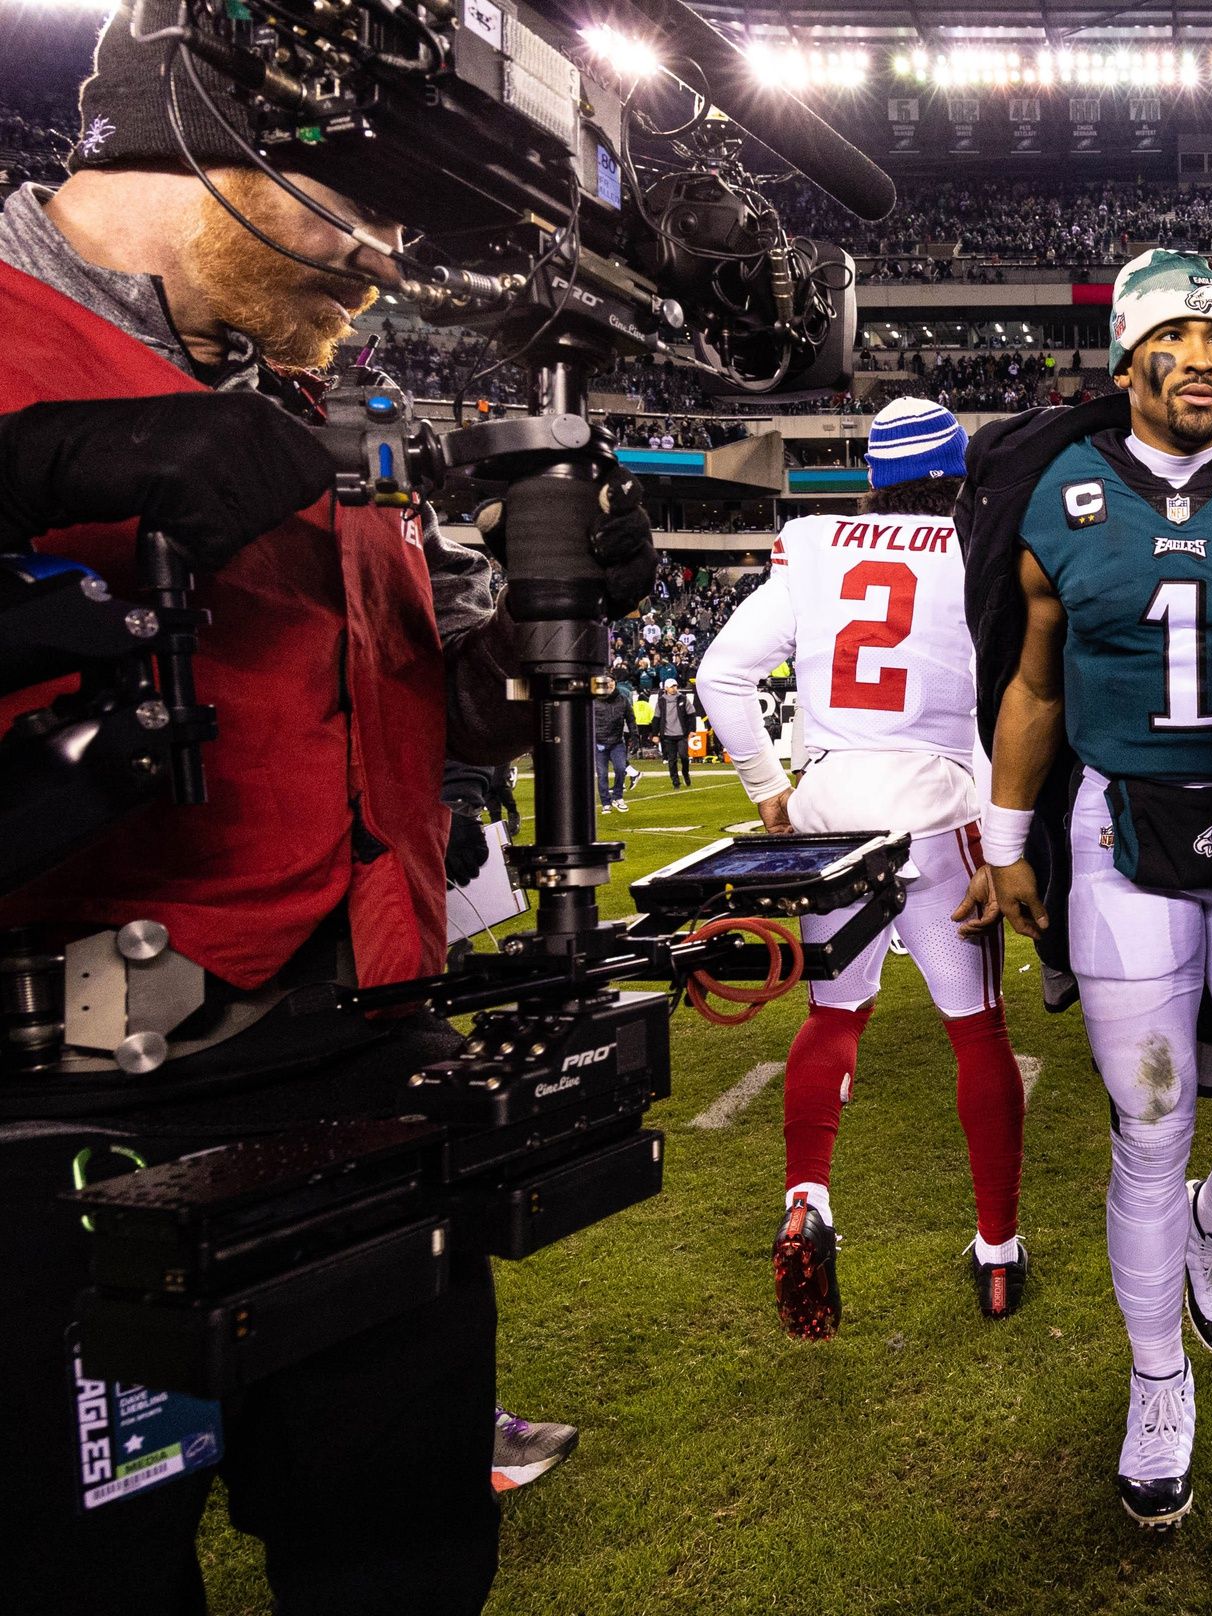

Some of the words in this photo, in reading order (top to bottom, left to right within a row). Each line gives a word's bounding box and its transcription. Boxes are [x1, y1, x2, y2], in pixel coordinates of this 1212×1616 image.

[552, 276, 600, 307] PRO
[1065, 482, 1103, 517] C
[831, 521, 954, 553] TAYLOR
[1153, 537, 1207, 558] EAGLES
[829, 560, 918, 712] 2
[688, 735, 703, 751] G
[561, 1045, 612, 1072] PRO
[74, 1358, 112, 1485] AGLES
